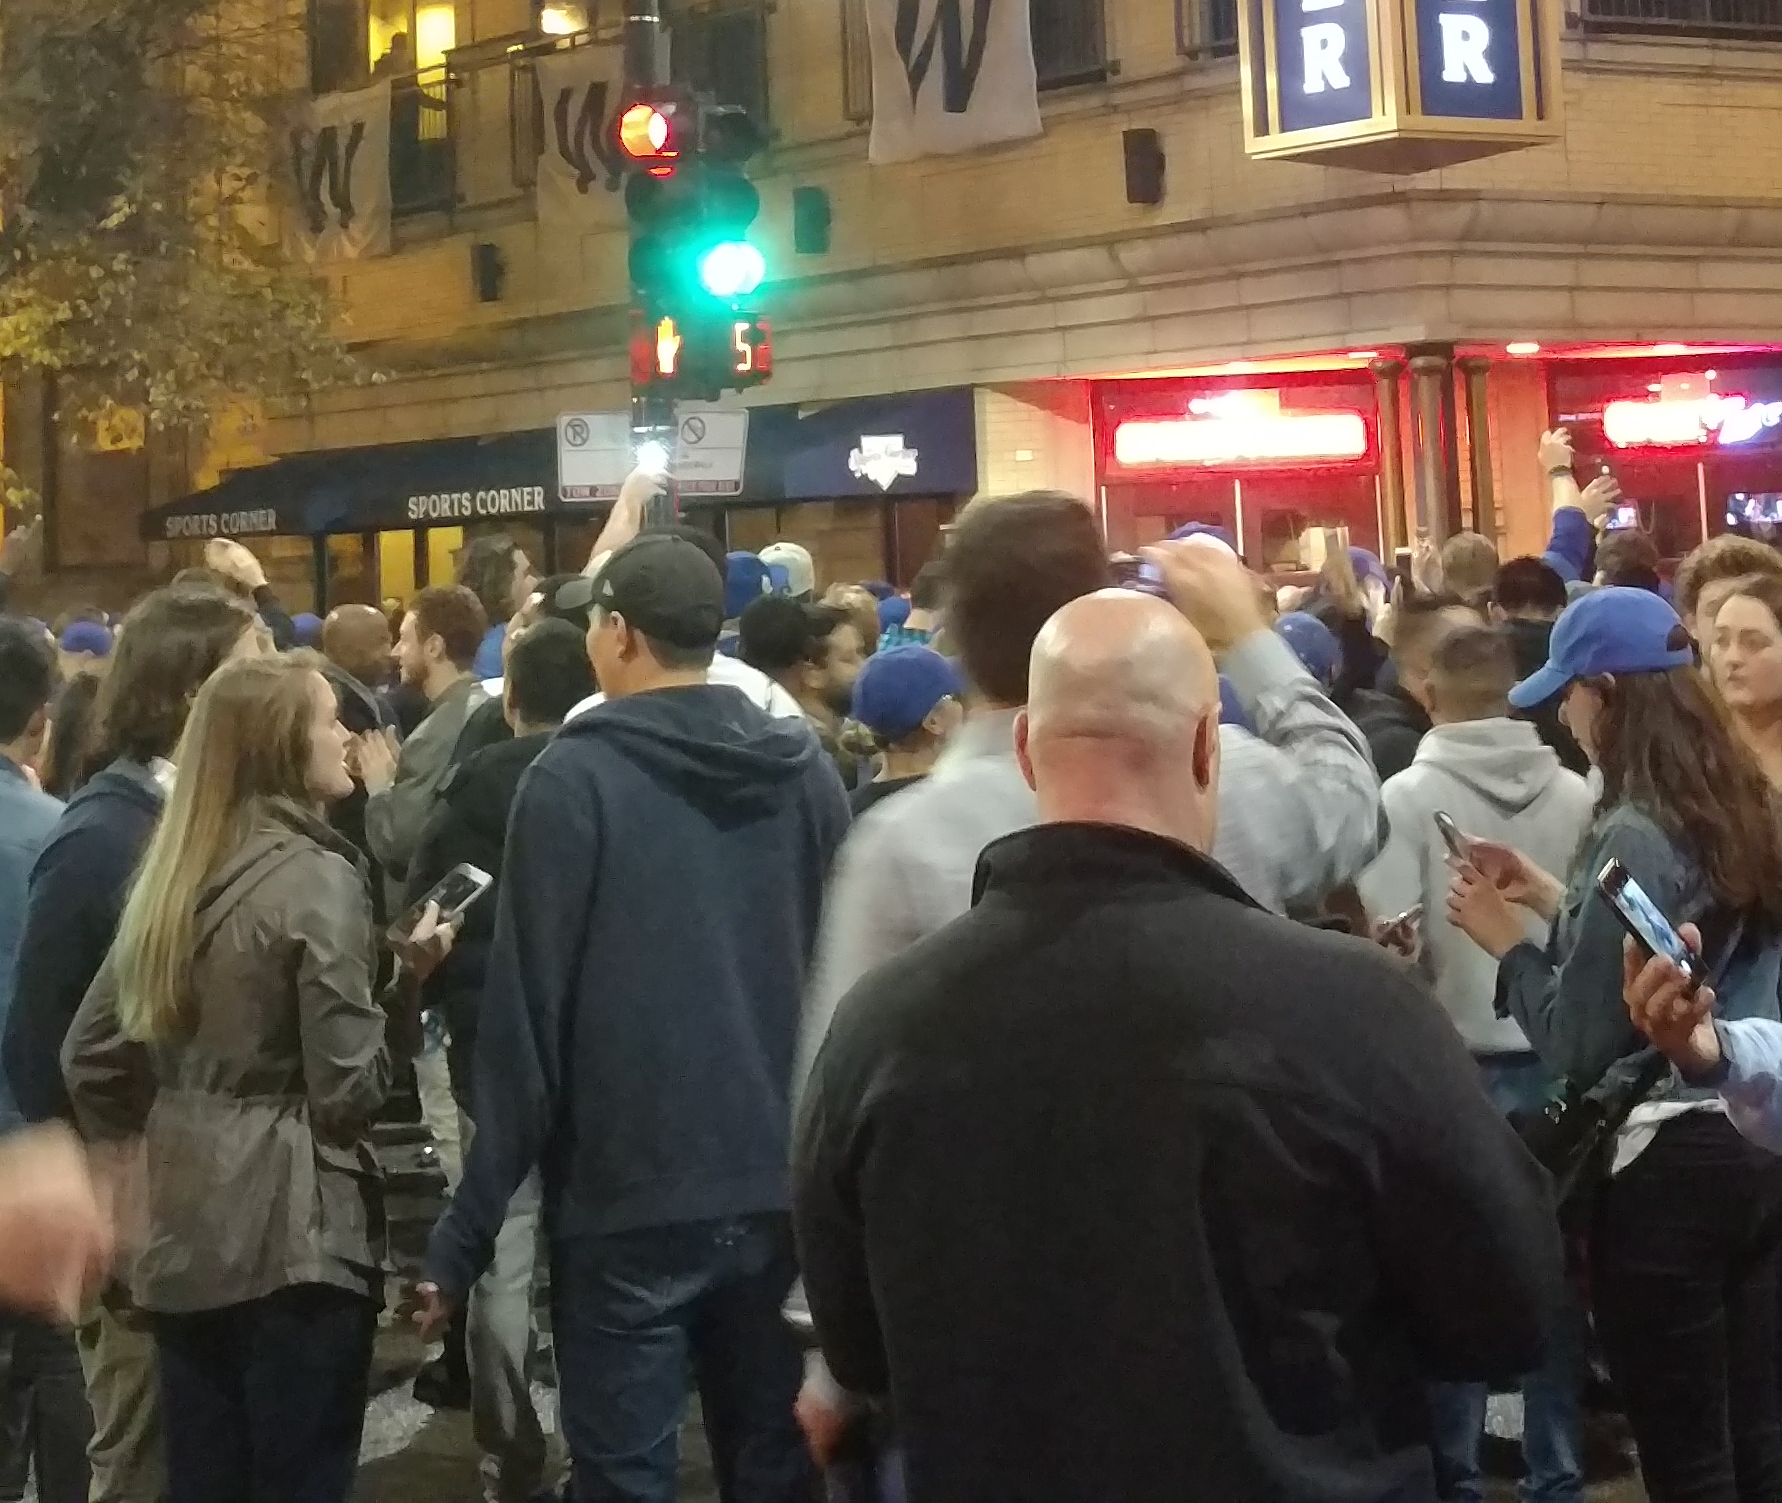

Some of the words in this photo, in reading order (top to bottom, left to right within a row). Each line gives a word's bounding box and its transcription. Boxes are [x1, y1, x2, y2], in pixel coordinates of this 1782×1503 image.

[290, 120, 366, 234] W
[408, 492, 472, 519] SPORTS
[476, 486, 545, 514] CORNER
[165, 513, 218, 537] SPORTS
[220, 508, 276, 534] CORNER
